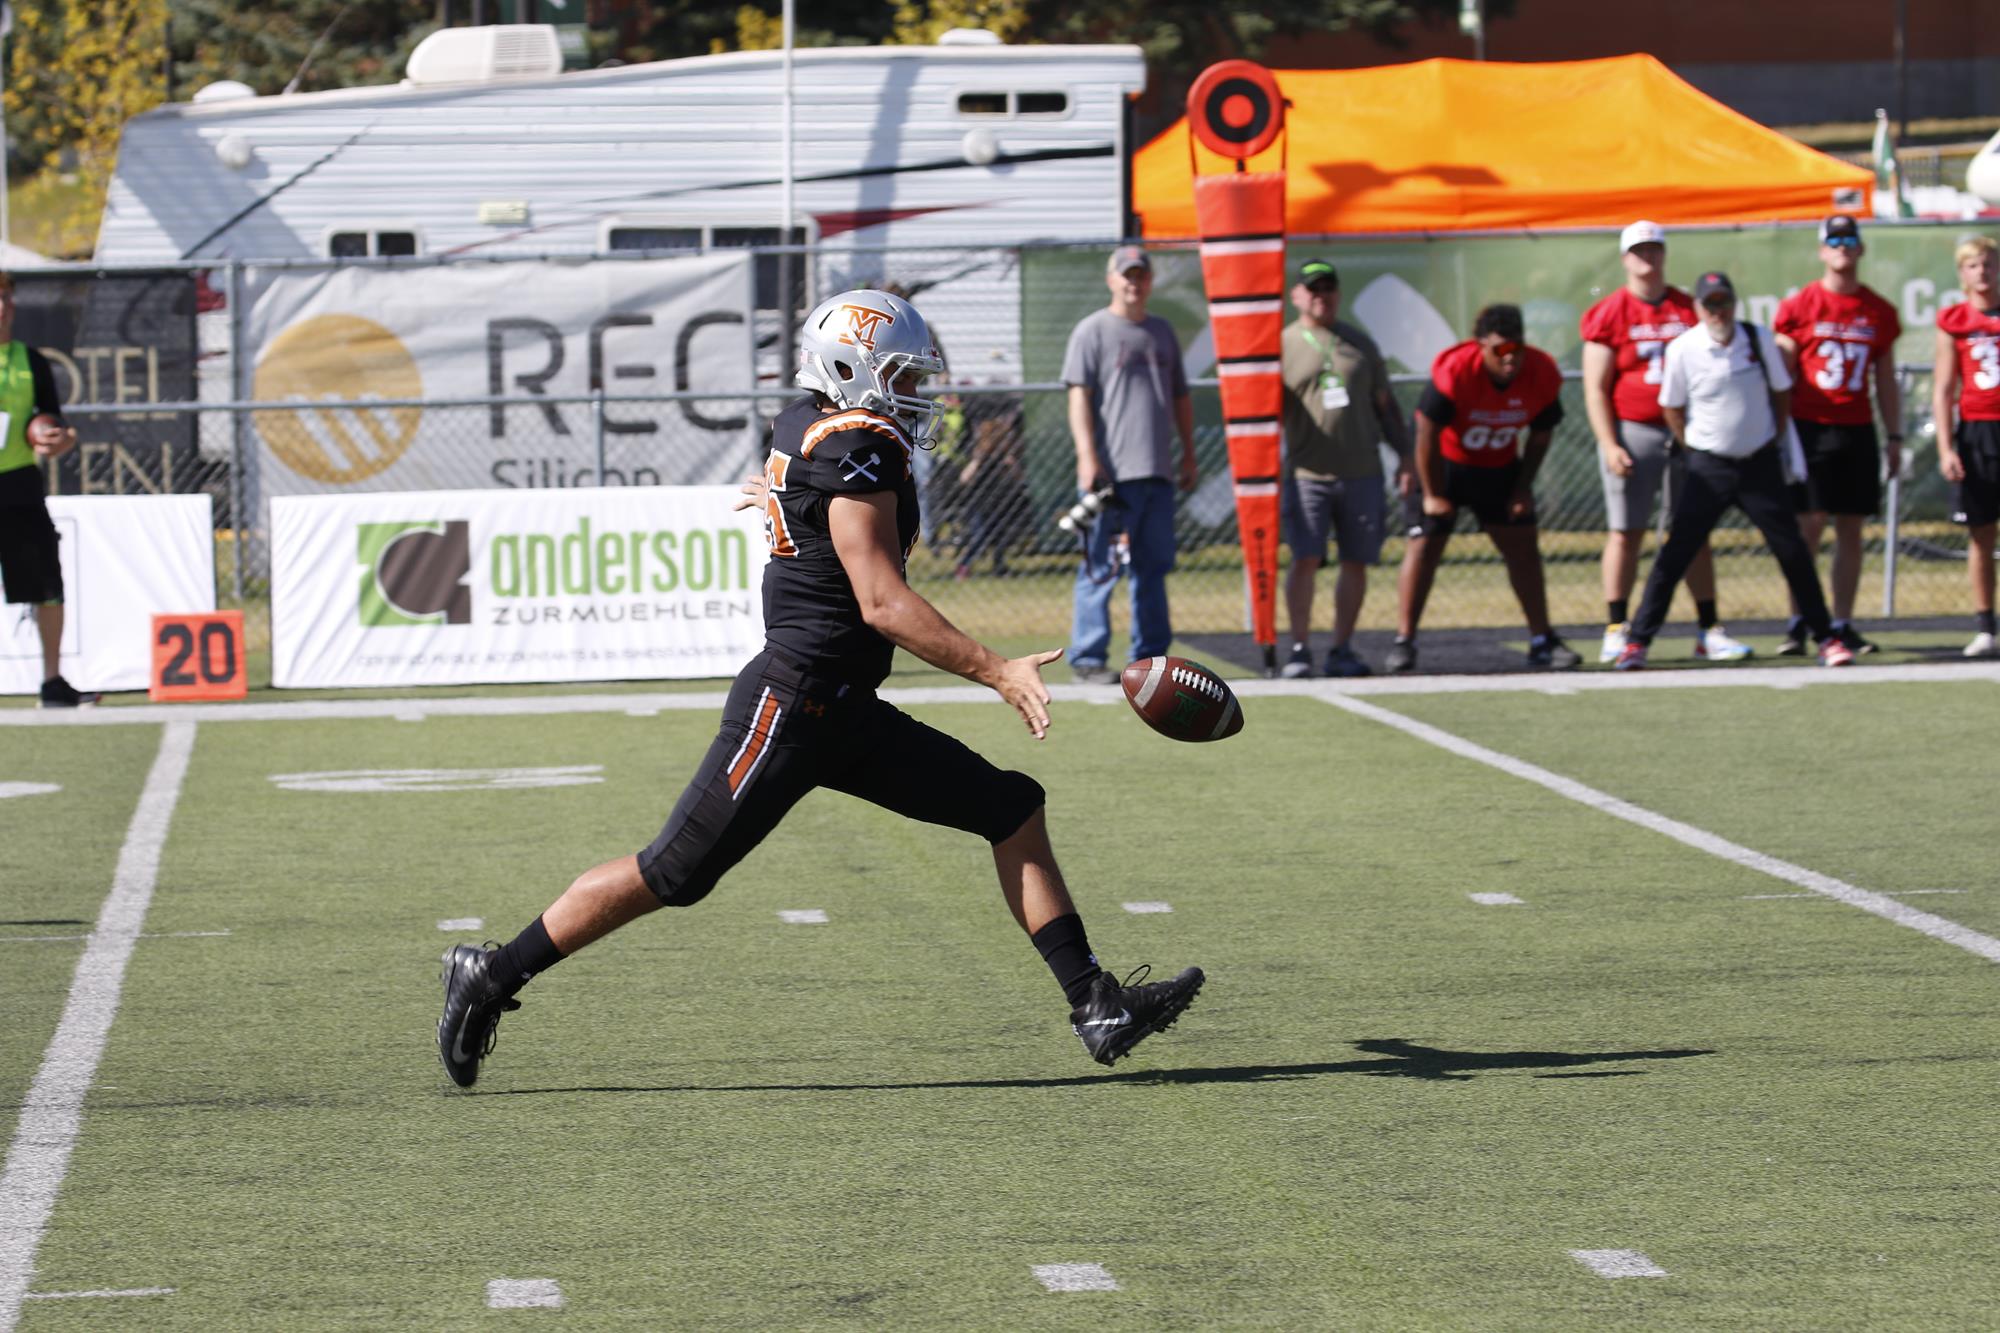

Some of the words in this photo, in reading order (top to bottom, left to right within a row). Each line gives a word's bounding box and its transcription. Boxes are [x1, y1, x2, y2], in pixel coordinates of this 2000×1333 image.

[488, 311, 748, 438] REC
[1815, 340, 1870, 391] 37
[490, 458, 660, 489] Silicon
[491, 516, 749, 598] anderson
[492, 600, 751, 626] ZURMUEHLEN
[158, 621, 236, 687] 20
